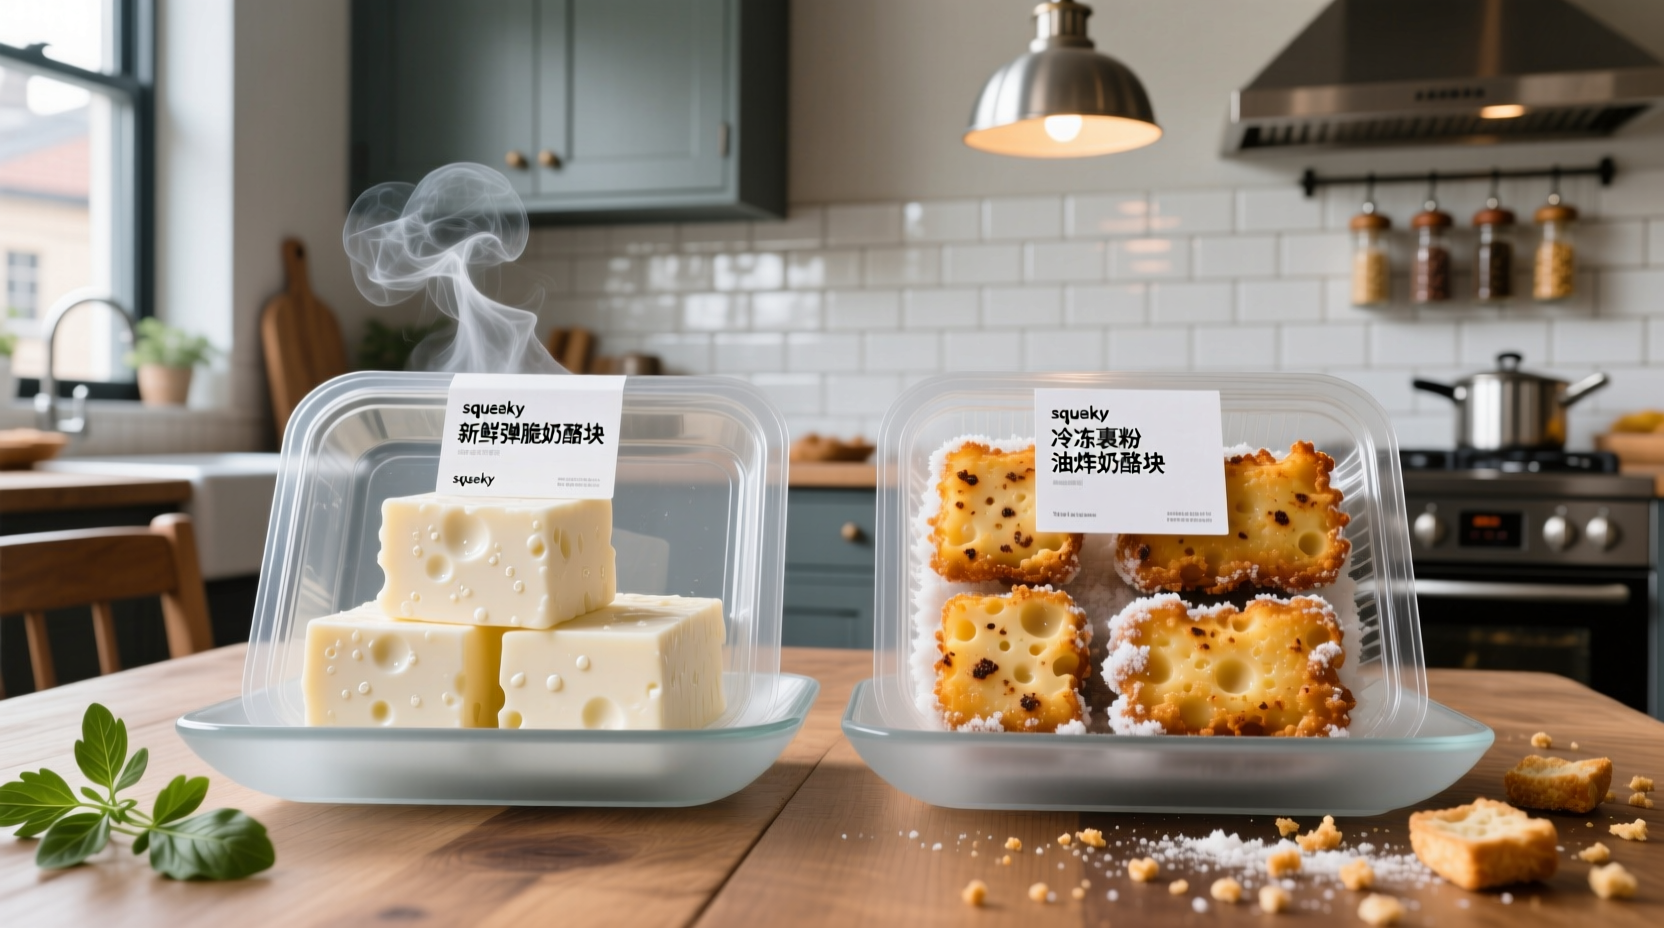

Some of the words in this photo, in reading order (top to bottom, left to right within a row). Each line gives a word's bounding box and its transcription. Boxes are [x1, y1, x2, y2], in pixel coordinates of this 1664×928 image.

[457, 421, 605, 445] 新鲜弹脆奶酪块
[1051, 451, 1166, 475] 油炸奶酪块
